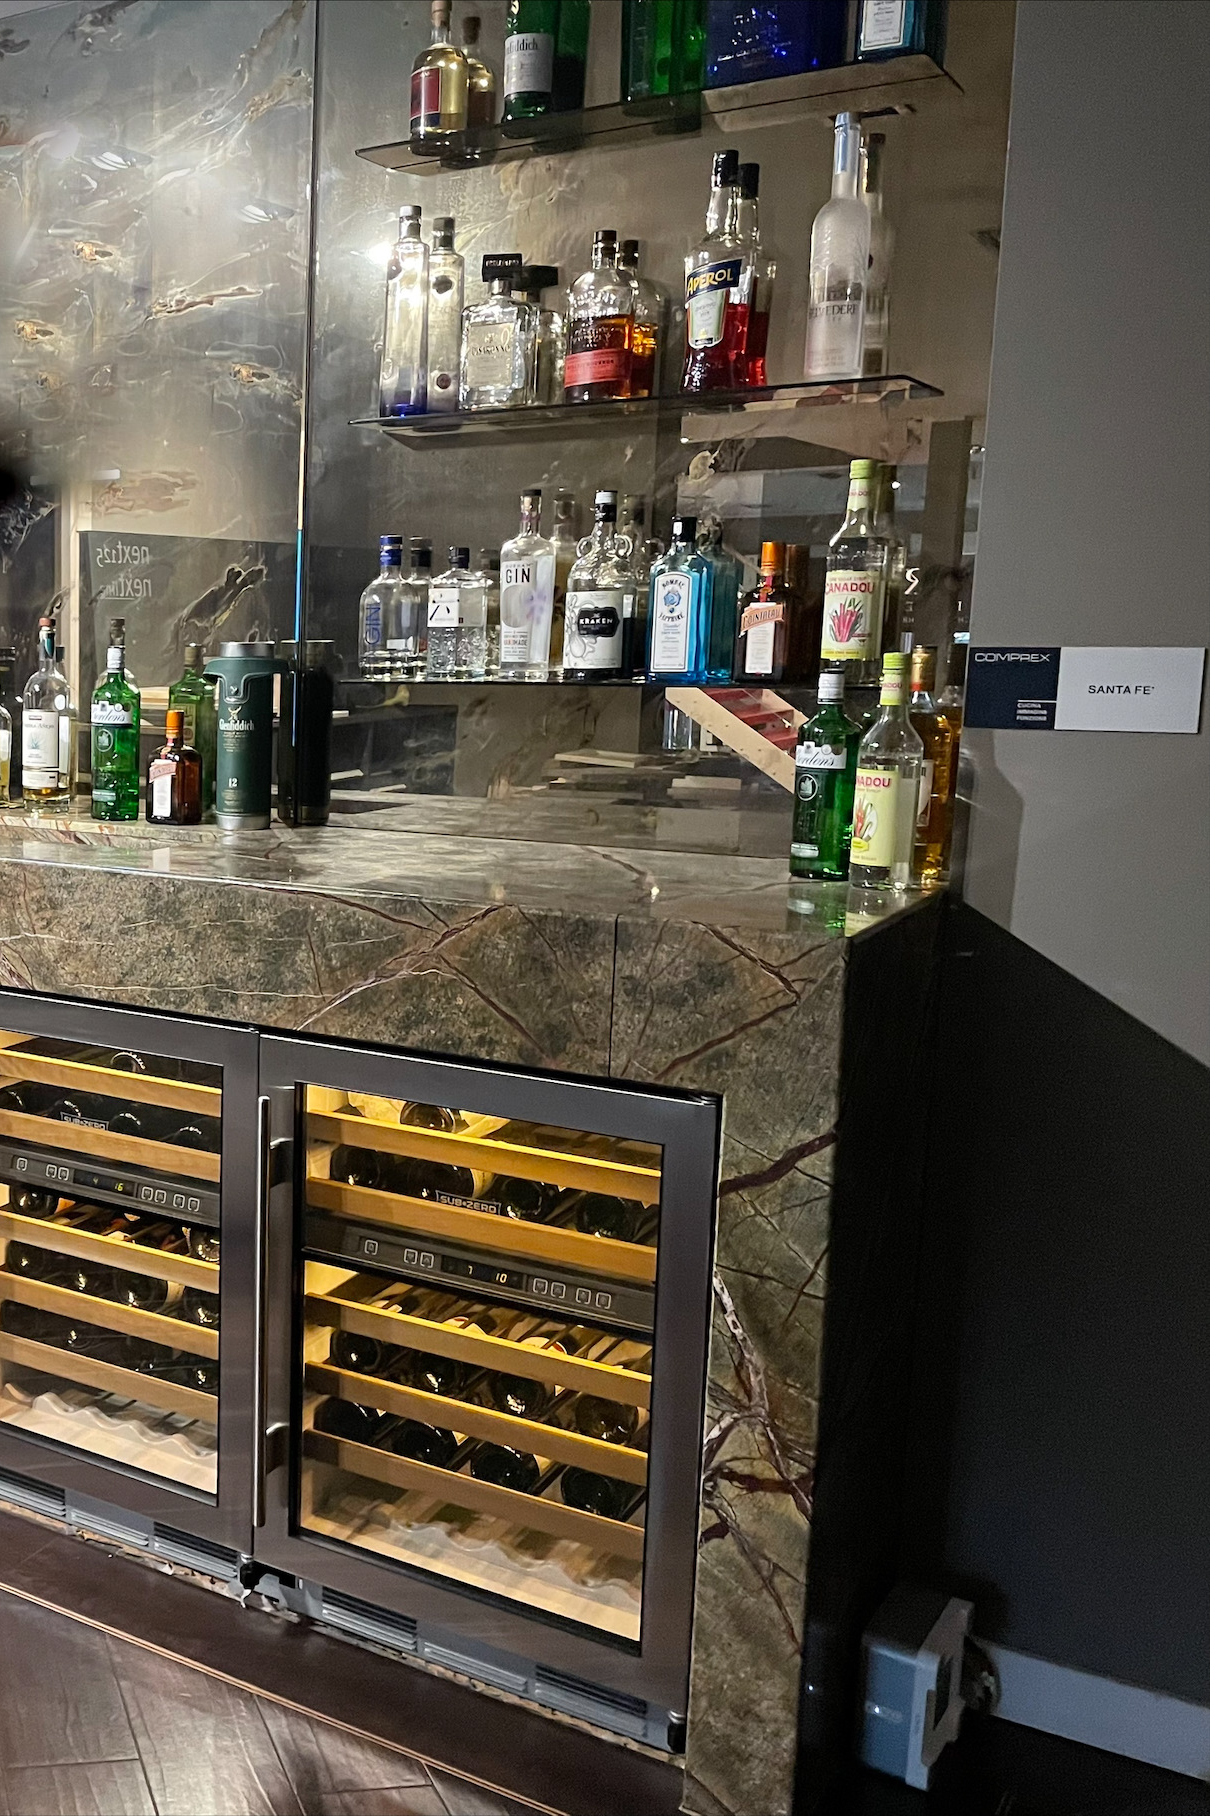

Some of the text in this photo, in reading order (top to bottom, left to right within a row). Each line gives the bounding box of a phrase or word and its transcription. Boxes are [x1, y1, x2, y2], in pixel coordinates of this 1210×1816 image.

[687, 268, 734, 296] APEROL
[506, 568, 531, 583] GIN
[825, 582, 875, 595] CANADOU
[365, 607, 381, 645] GIN
[1088, 684, 1132, 695] SANTA
[228, 777, 238, 789] 12
[496, 1272, 507, 1283] 10
